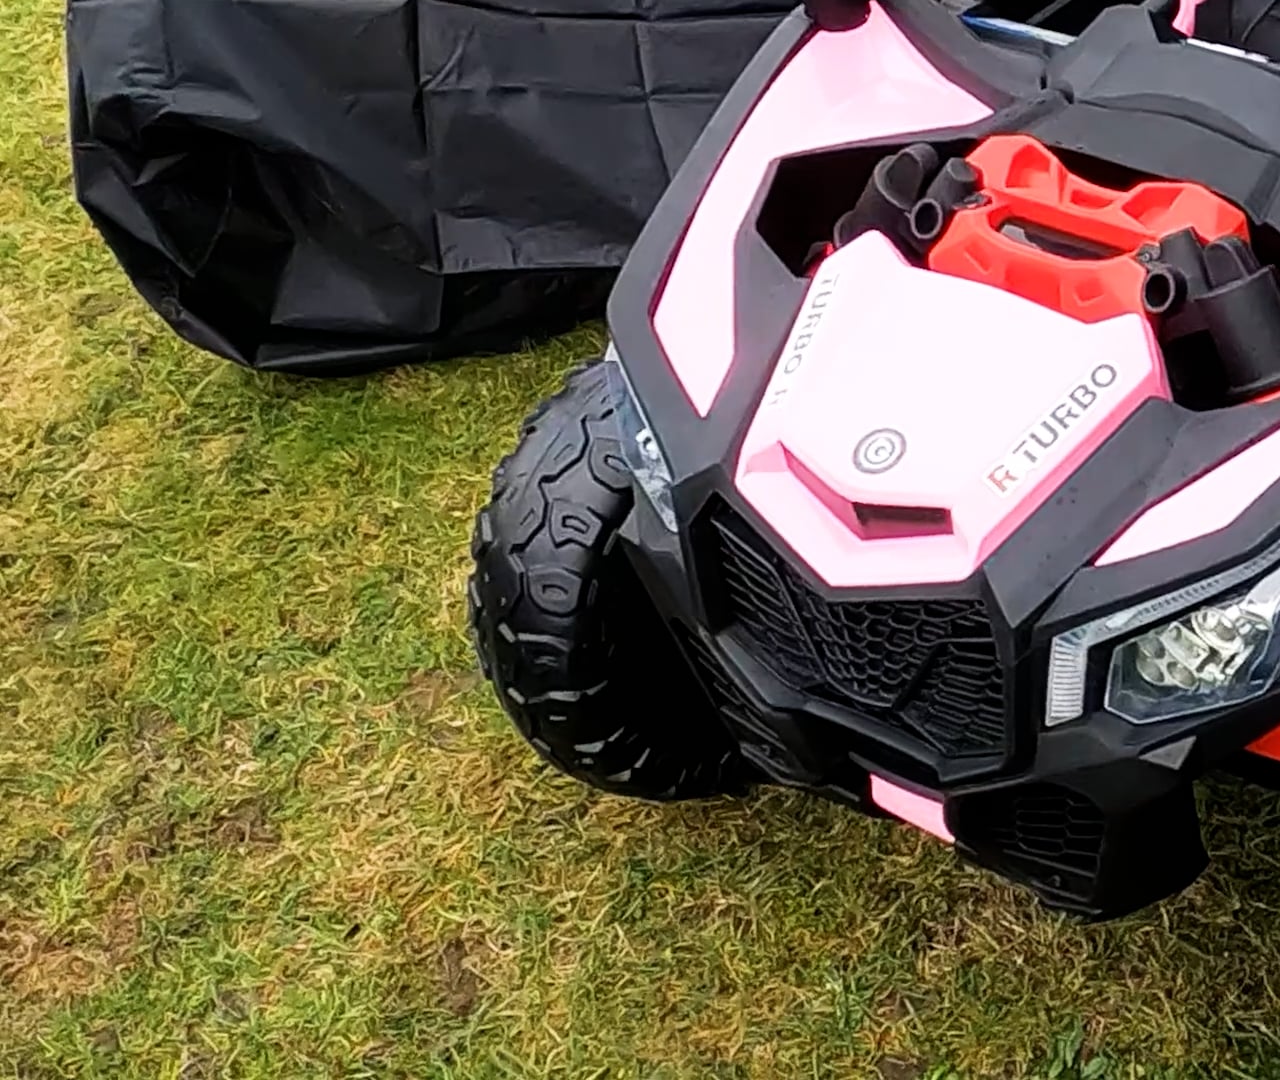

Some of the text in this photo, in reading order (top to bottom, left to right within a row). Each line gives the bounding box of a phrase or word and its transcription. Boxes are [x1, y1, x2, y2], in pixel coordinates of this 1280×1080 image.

[784, 273, 840, 375] TURBO
[986, 363, 1118, 493] R TURBO
